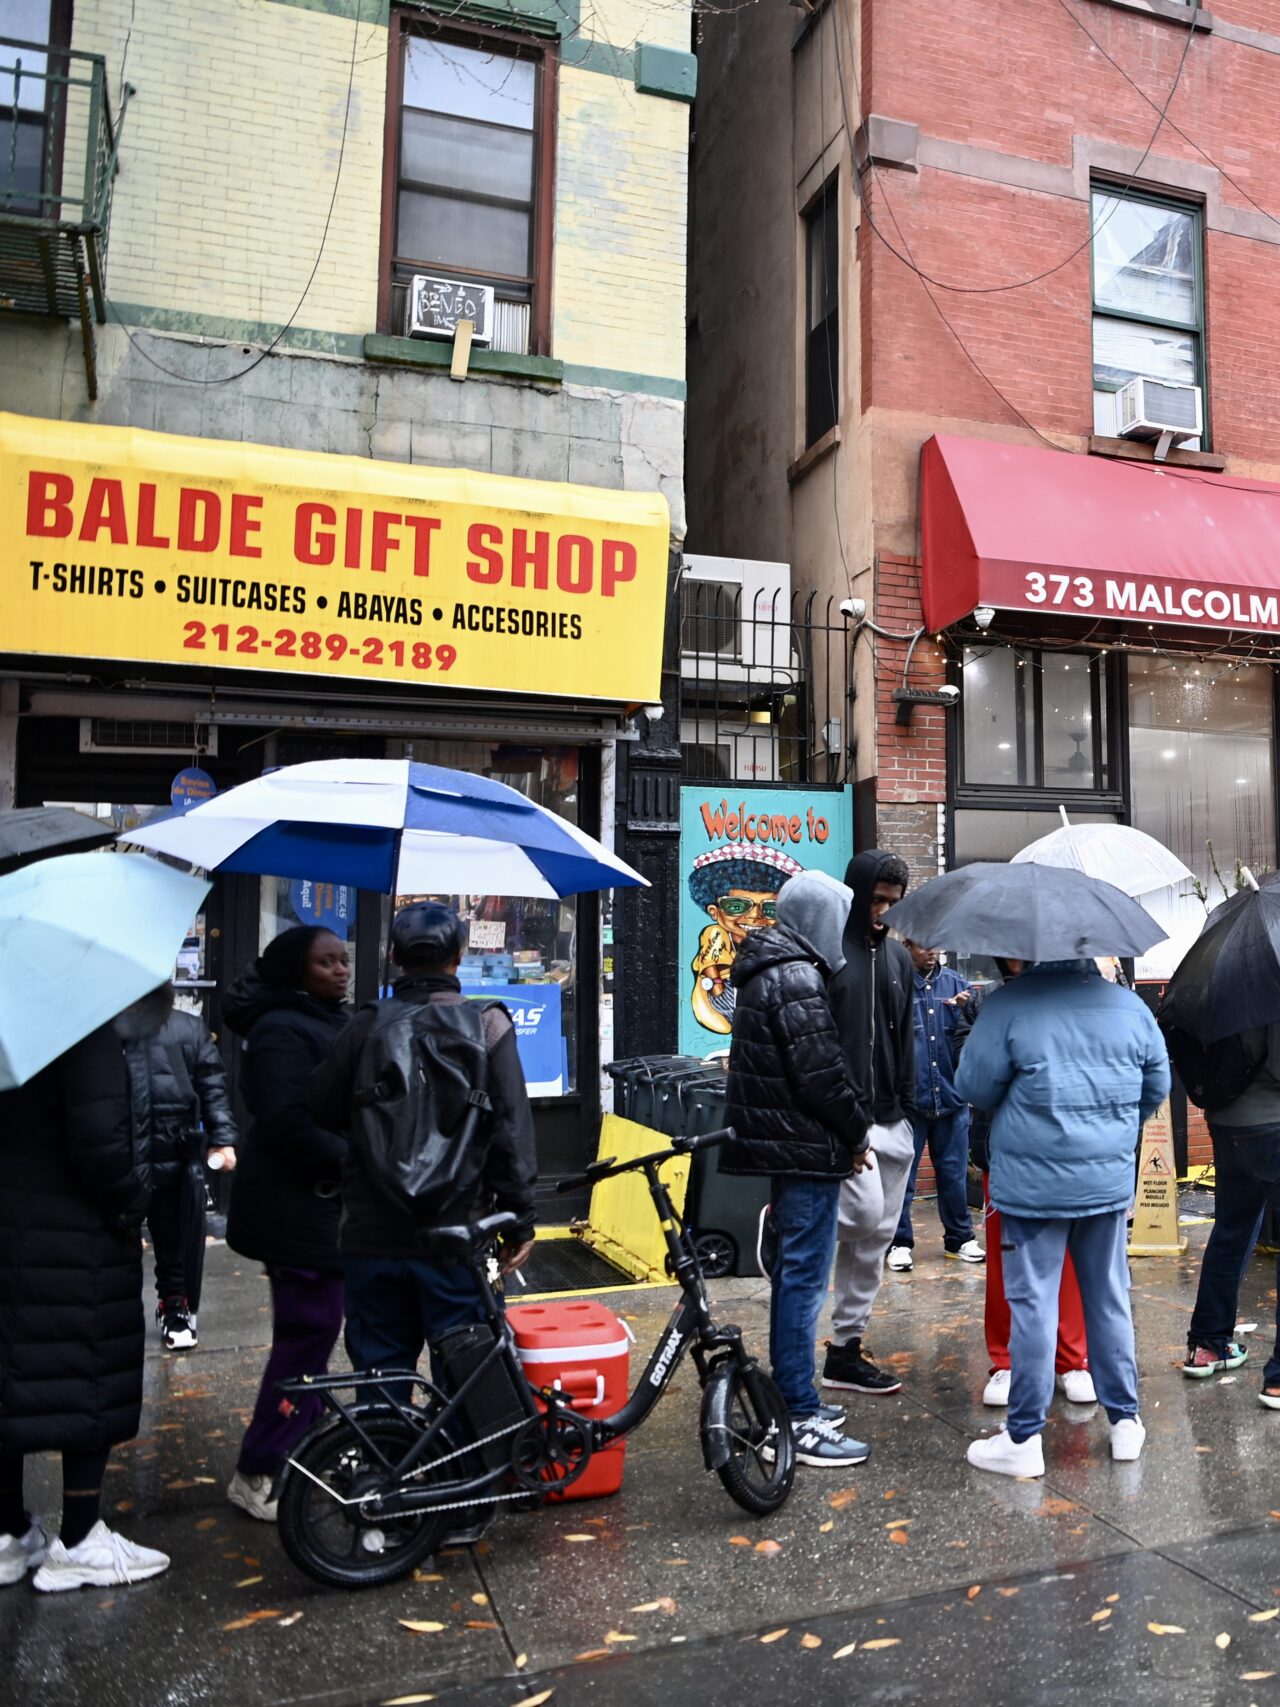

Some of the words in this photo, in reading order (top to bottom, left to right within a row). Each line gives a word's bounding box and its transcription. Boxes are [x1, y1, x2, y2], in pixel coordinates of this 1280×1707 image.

[26, 470, 263, 558] BALDE
[293, 502, 441, 577] GIFT
[466, 523, 638, 597] SHOP
[29, 560, 144, 599] T-SHIRTS
[176, 574, 306, 615] SUITCASES
[337, 590, 423, 626] ABAYAS
[452, 602, 582, 641] ACCESORIES
[1024, 571, 1094, 608] 373
[1106, 580, 1278, 627] MALCOLM
[183, 620, 457, 672] 212-289-2189
[700, 799, 803, 846] Welcome
[807, 806, 829, 844] to
[649, 1327, 684, 1388] GOTRAX
